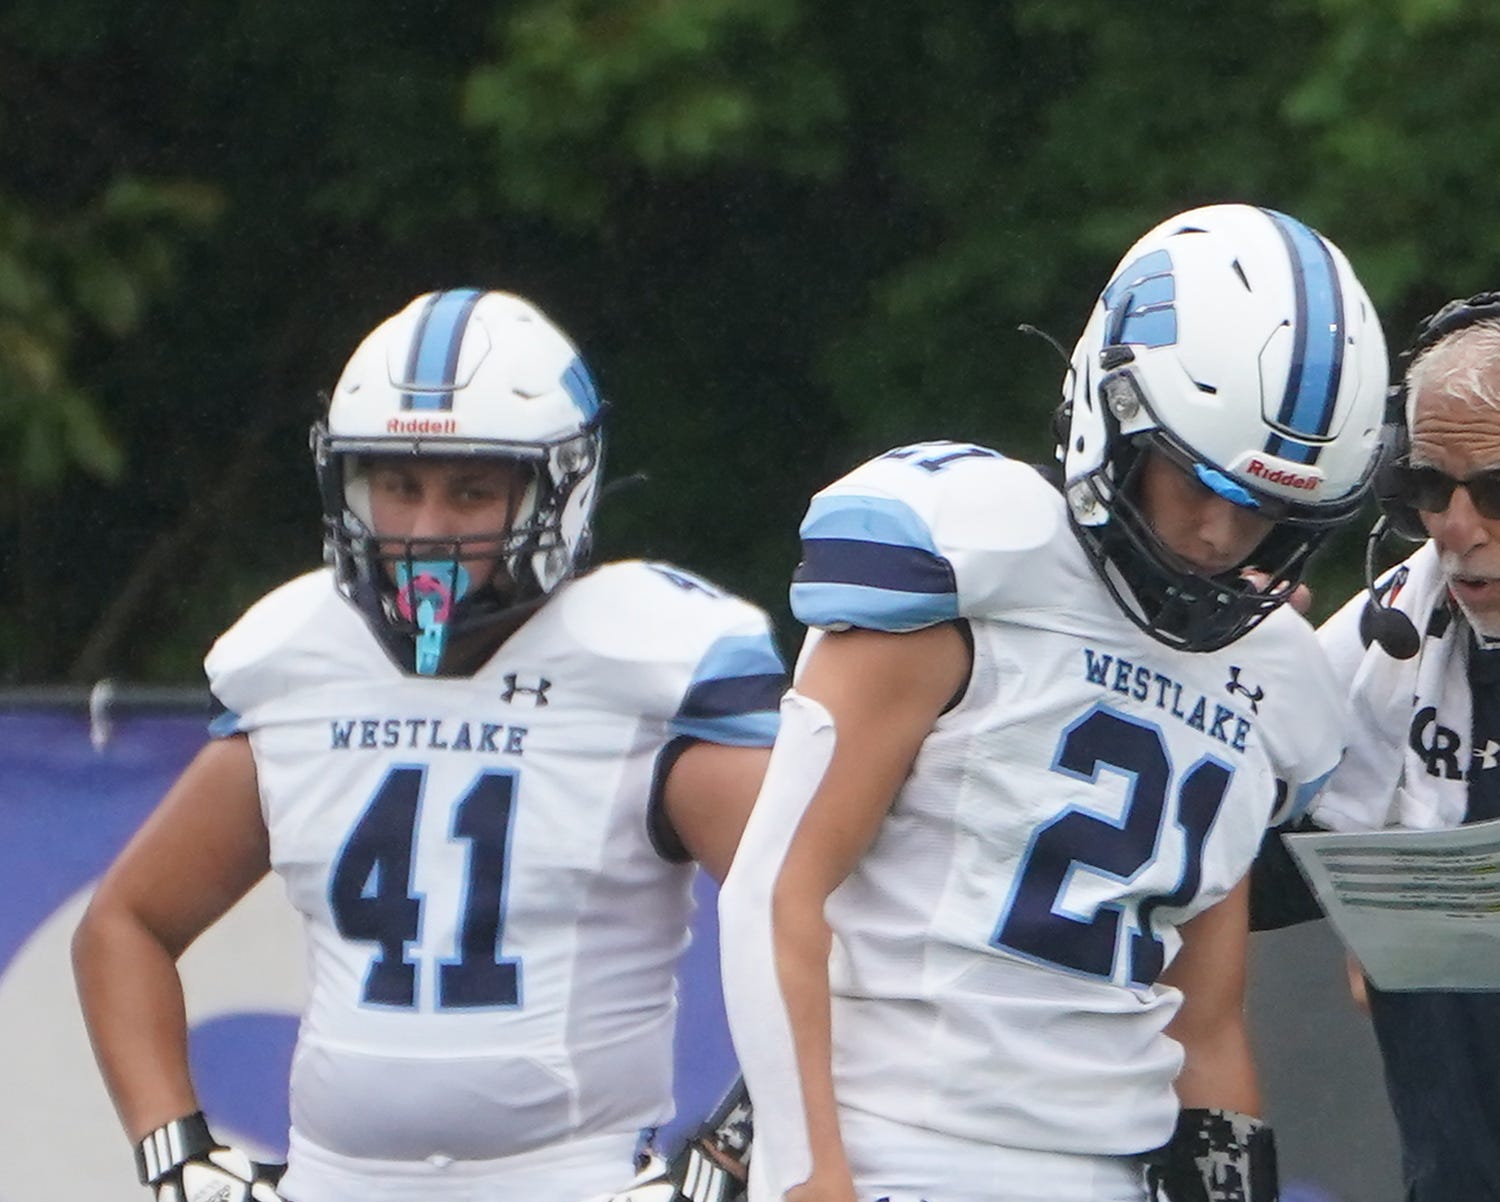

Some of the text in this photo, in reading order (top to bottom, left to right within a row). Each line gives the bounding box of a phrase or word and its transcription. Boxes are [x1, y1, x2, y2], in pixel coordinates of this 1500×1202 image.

[387, 418, 456, 434] Riddell
[1246, 459, 1319, 490] Riddell
[1084, 648, 1252, 754] WESTLAKE
[331, 719, 528, 756] WESTLAKE
[992, 699, 1236, 989] 21
[328, 762, 524, 1014] 41
